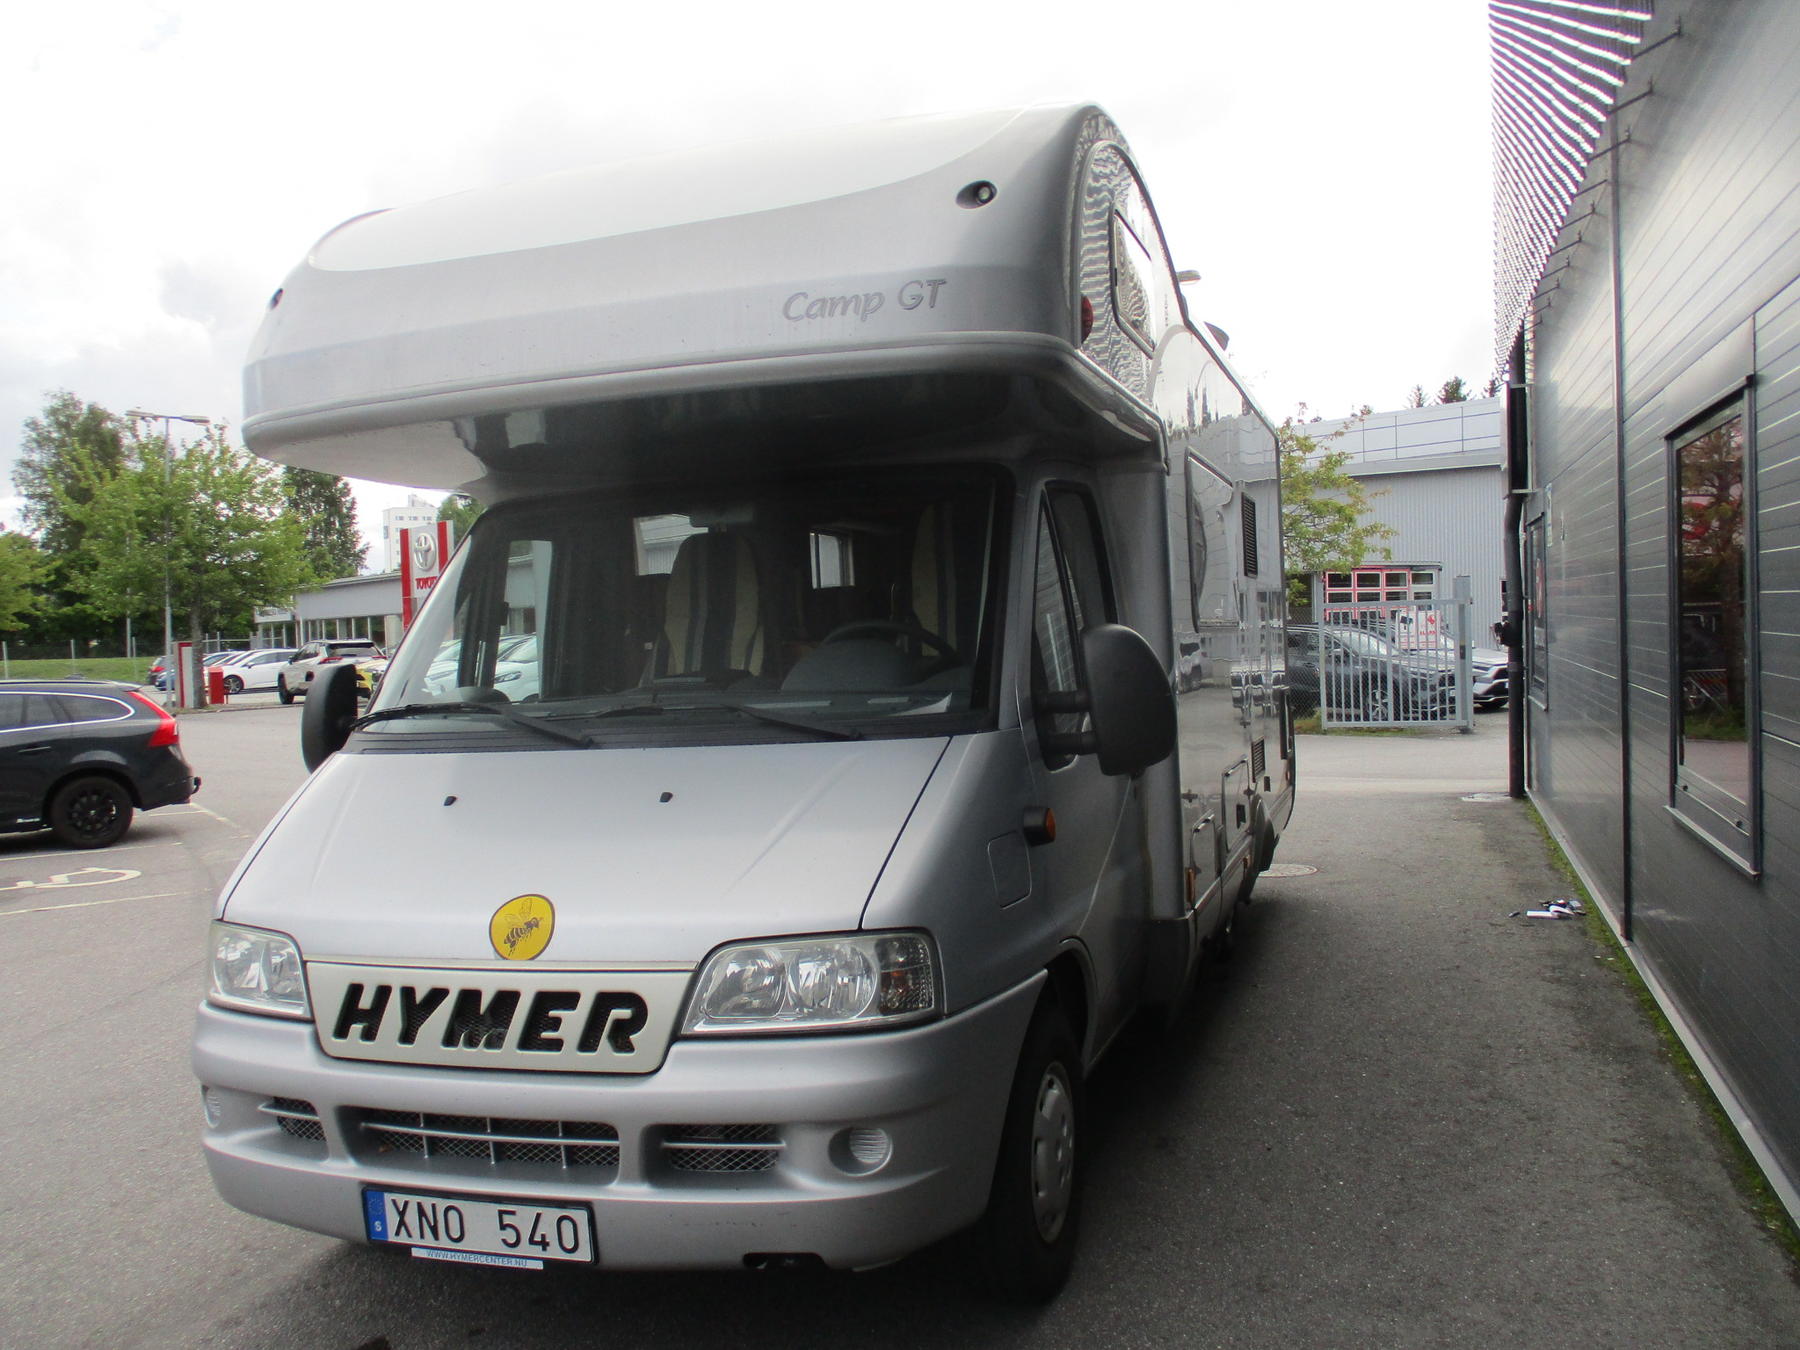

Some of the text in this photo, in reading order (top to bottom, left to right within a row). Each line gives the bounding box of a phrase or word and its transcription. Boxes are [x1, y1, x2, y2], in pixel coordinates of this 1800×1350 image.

[782, 278, 948, 322] Camp GT
[415, 576, 438, 589] TOYOT
[332, 982, 649, 1054] HYMER
[374, 1221, 382, 1232] S
[391, 1198, 580, 1255] XNO 540
